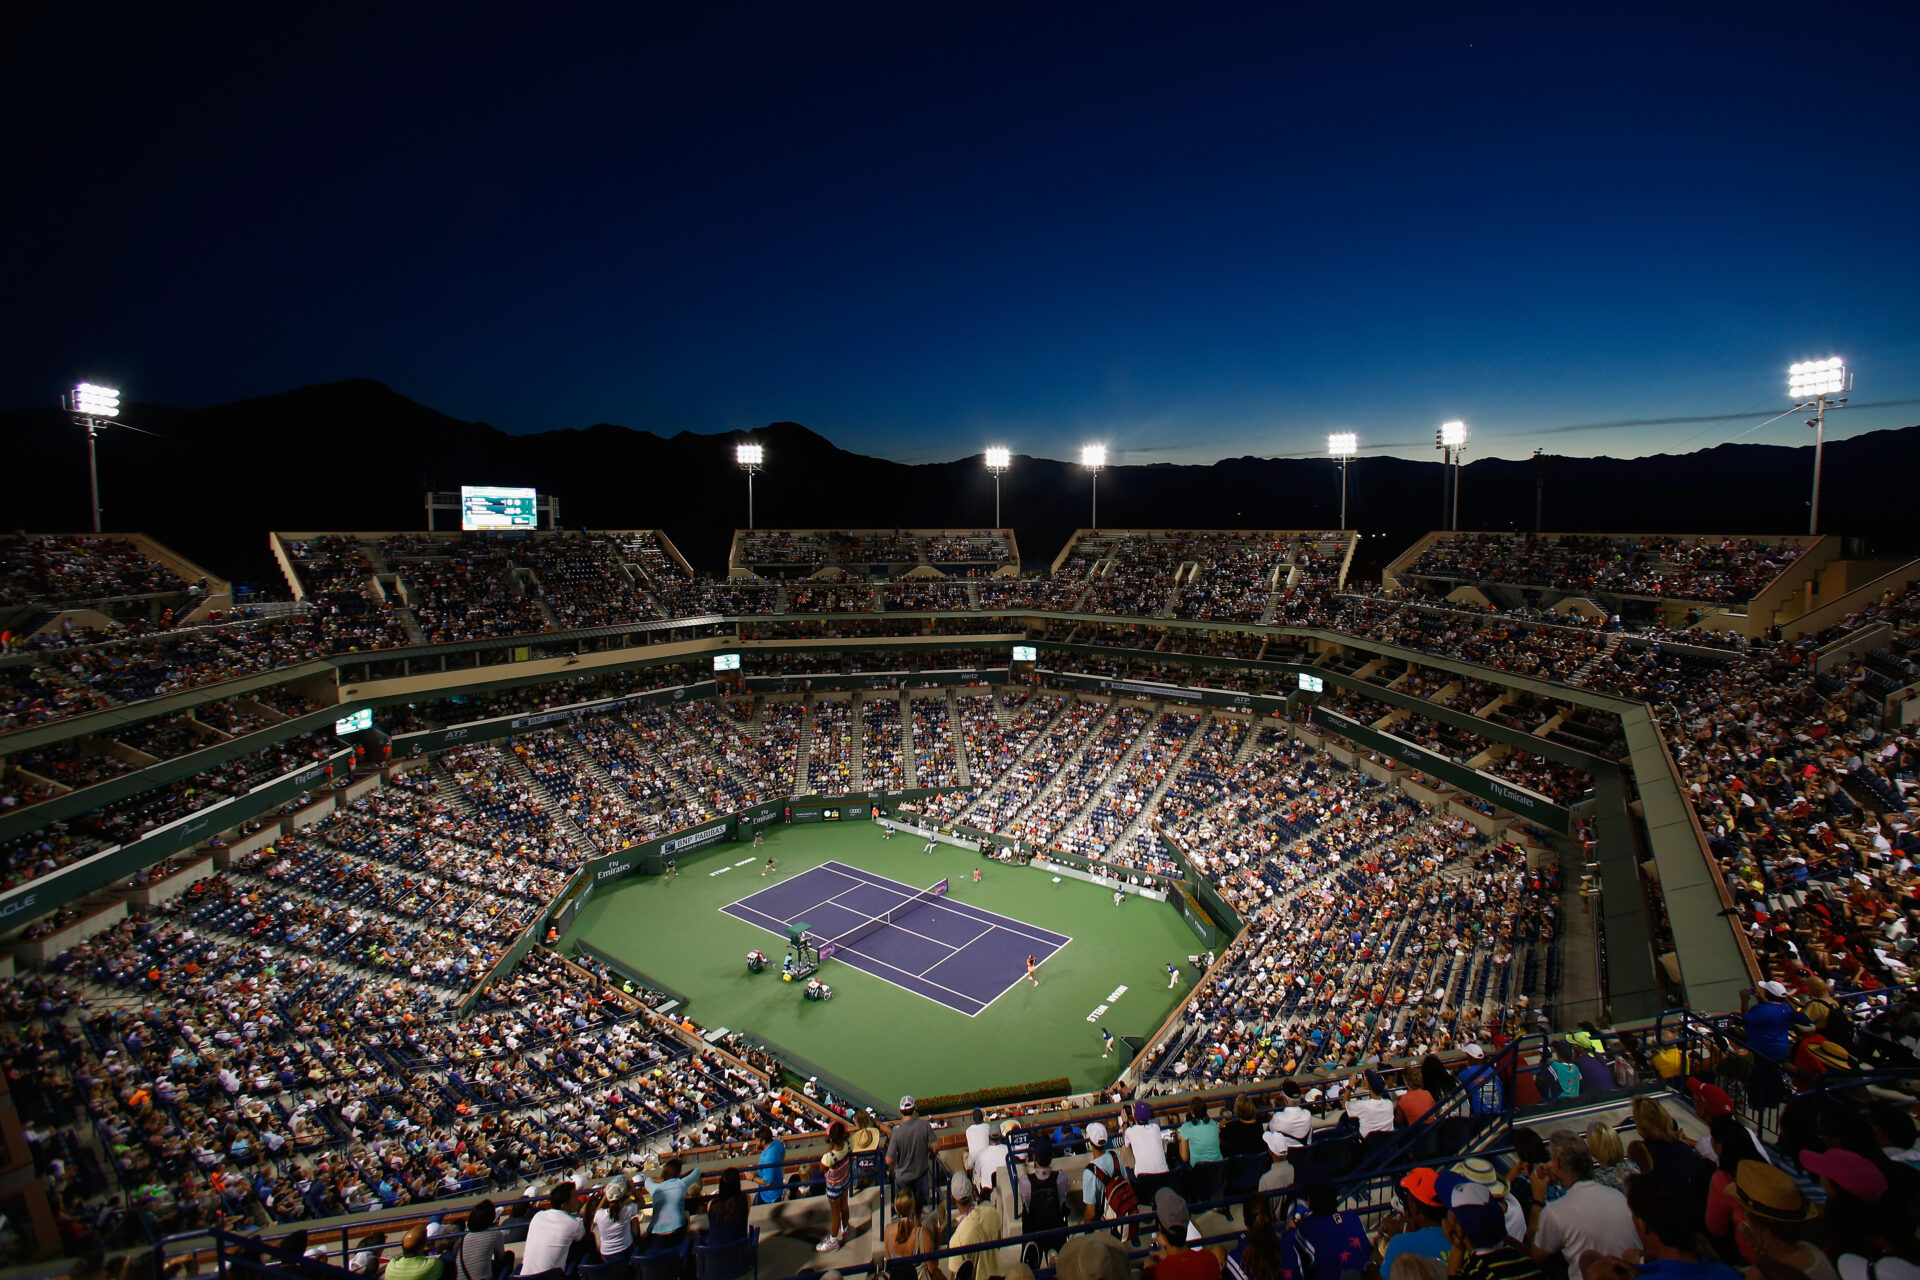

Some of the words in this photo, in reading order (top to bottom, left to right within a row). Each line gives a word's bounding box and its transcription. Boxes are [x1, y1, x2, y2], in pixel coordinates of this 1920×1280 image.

[961, 672, 978, 680] Hertz
[1234, 696, 1251, 705] ATP
[547, 711, 569, 722] PARIBA
[445, 729, 468, 741] ATP
[295, 775, 306, 785] Fly
[1490, 782, 1503, 797] Fly
[1503, 787, 1535, 808] Emirates
[753, 811, 777, 825] Emirates
[677, 836, 693, 848] BNP
[694, 825, 724, 841] PARIBAS
[608, 860, 619, 868] Fly
[597, 862, 631, 880] Emirates
[1014, 1136, 1027, 1144] 421
